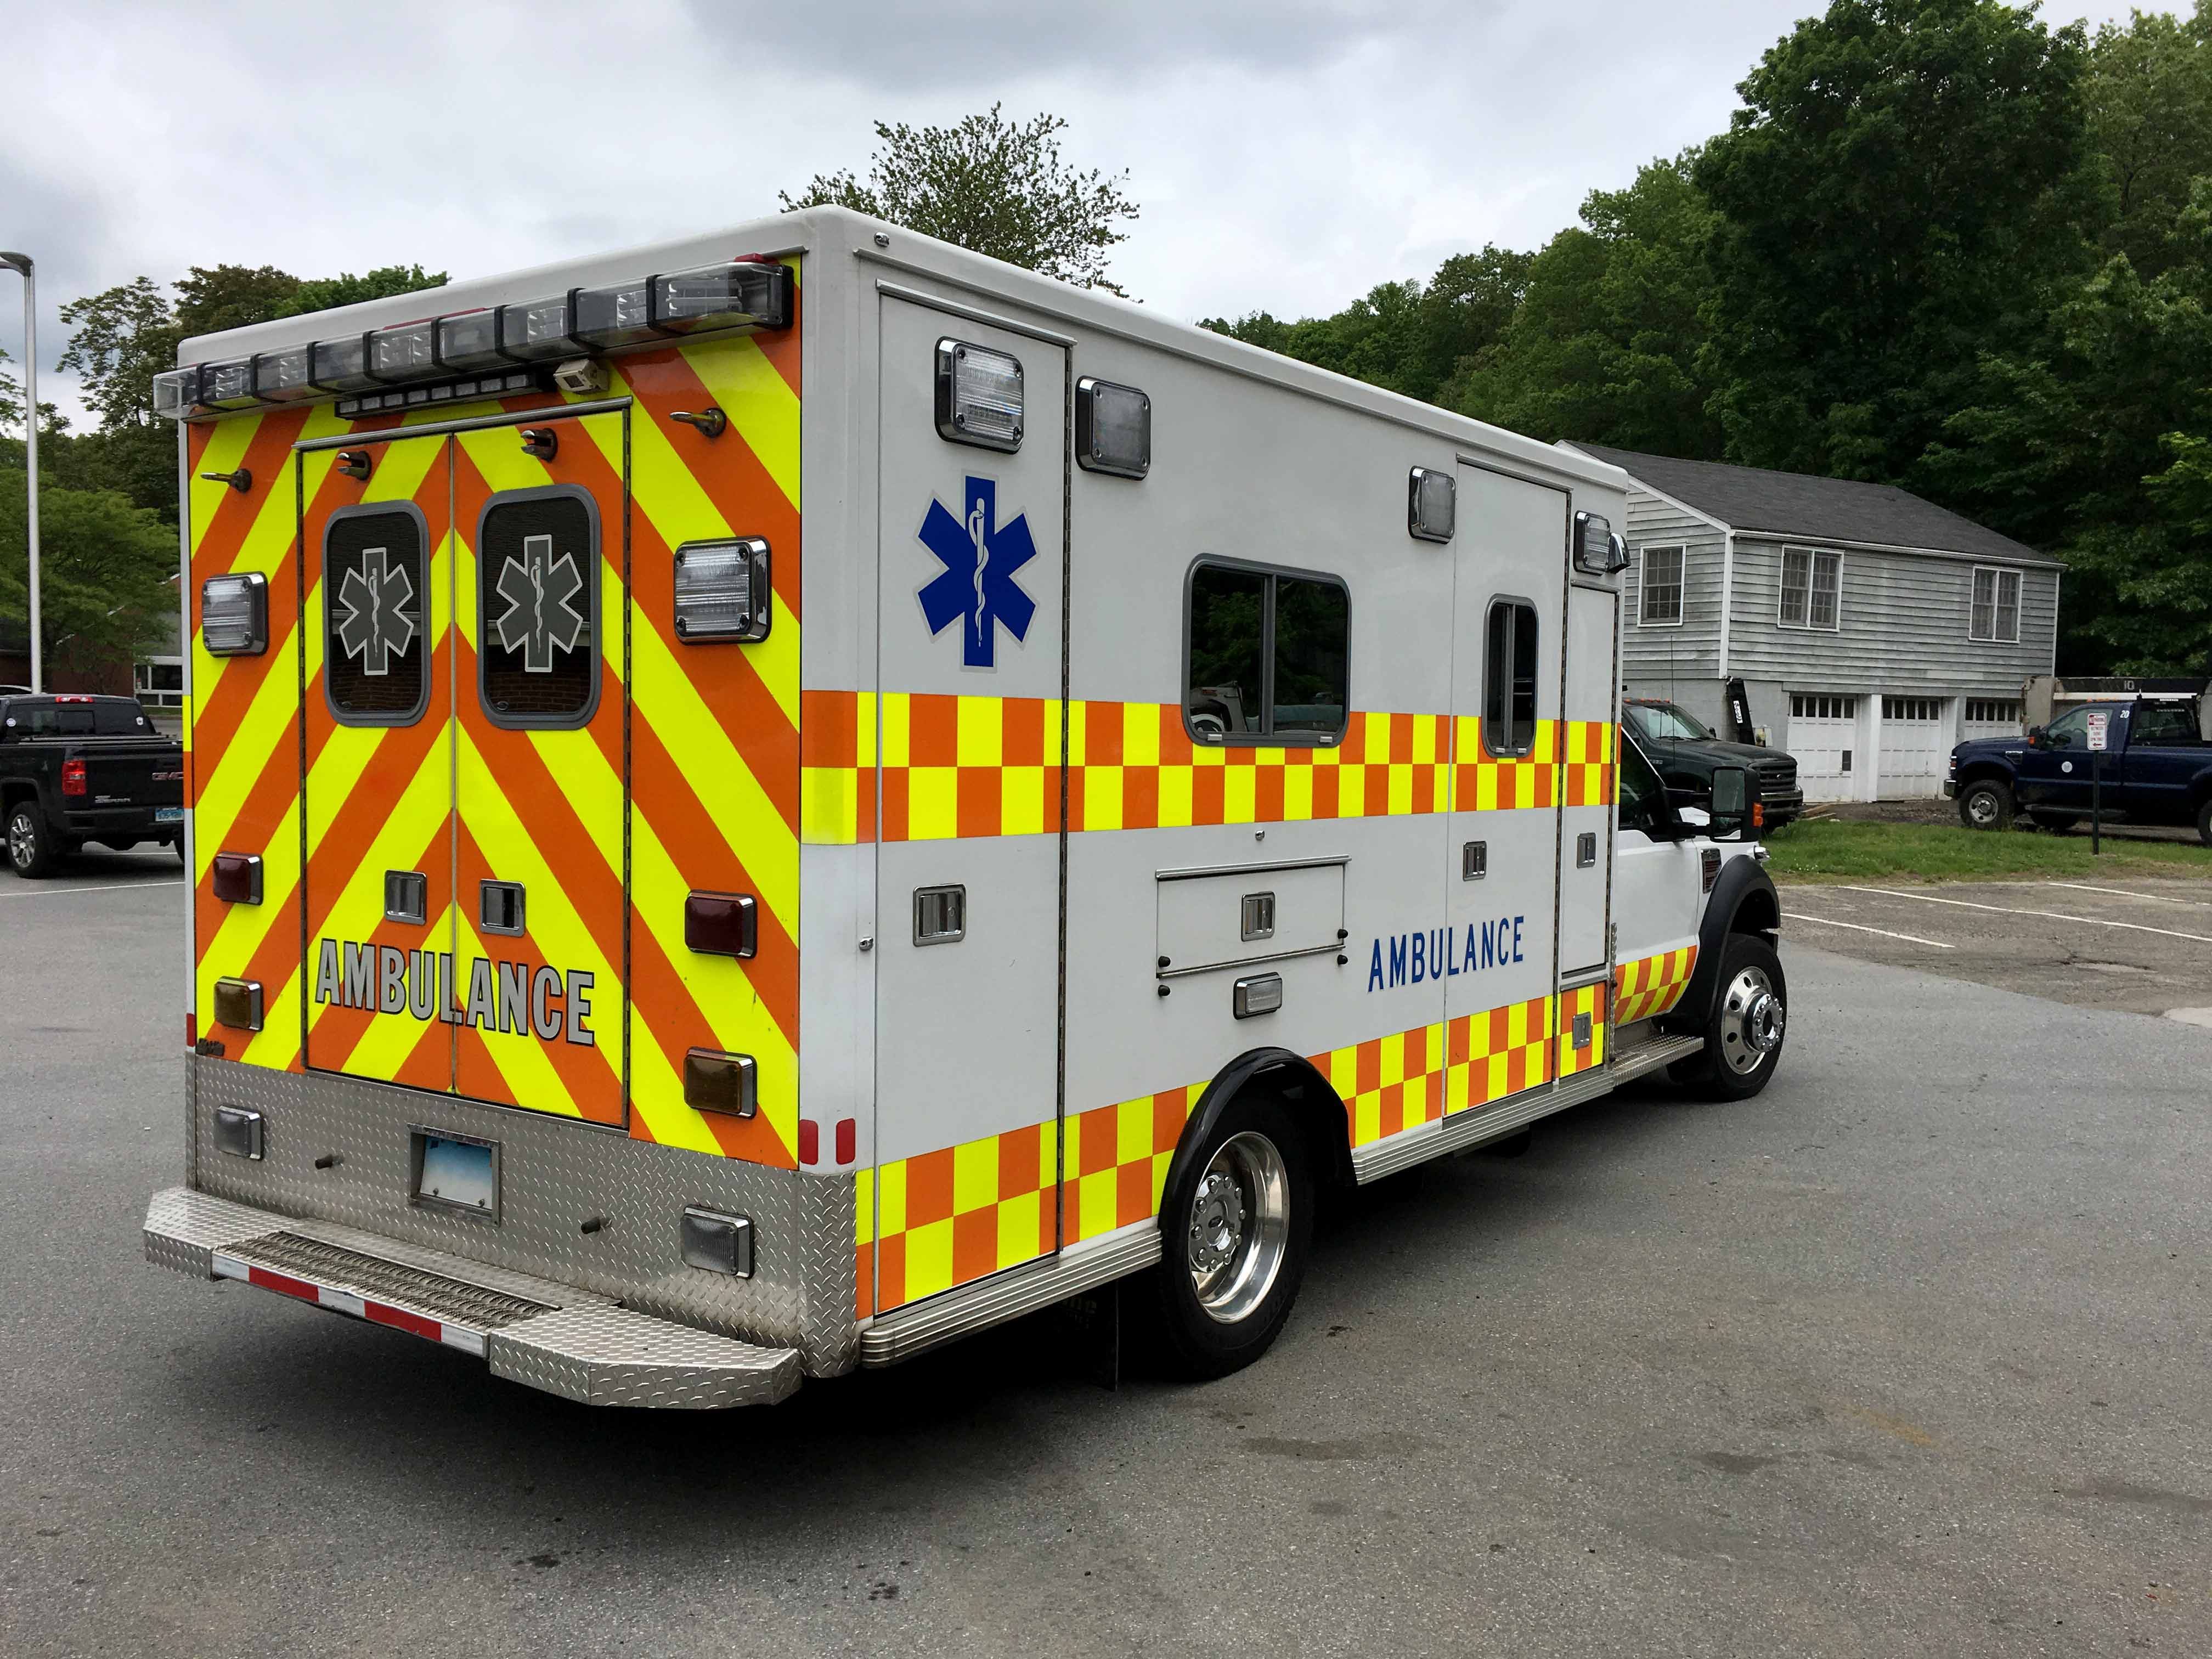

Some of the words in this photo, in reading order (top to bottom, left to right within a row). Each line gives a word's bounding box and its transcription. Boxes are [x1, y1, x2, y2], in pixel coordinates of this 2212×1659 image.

[2120, 709, 2130, 719] 20
[315, 938, 595, 1047] AMBULANCE
[1368, 915, 1524, 993] AMBULANCE
